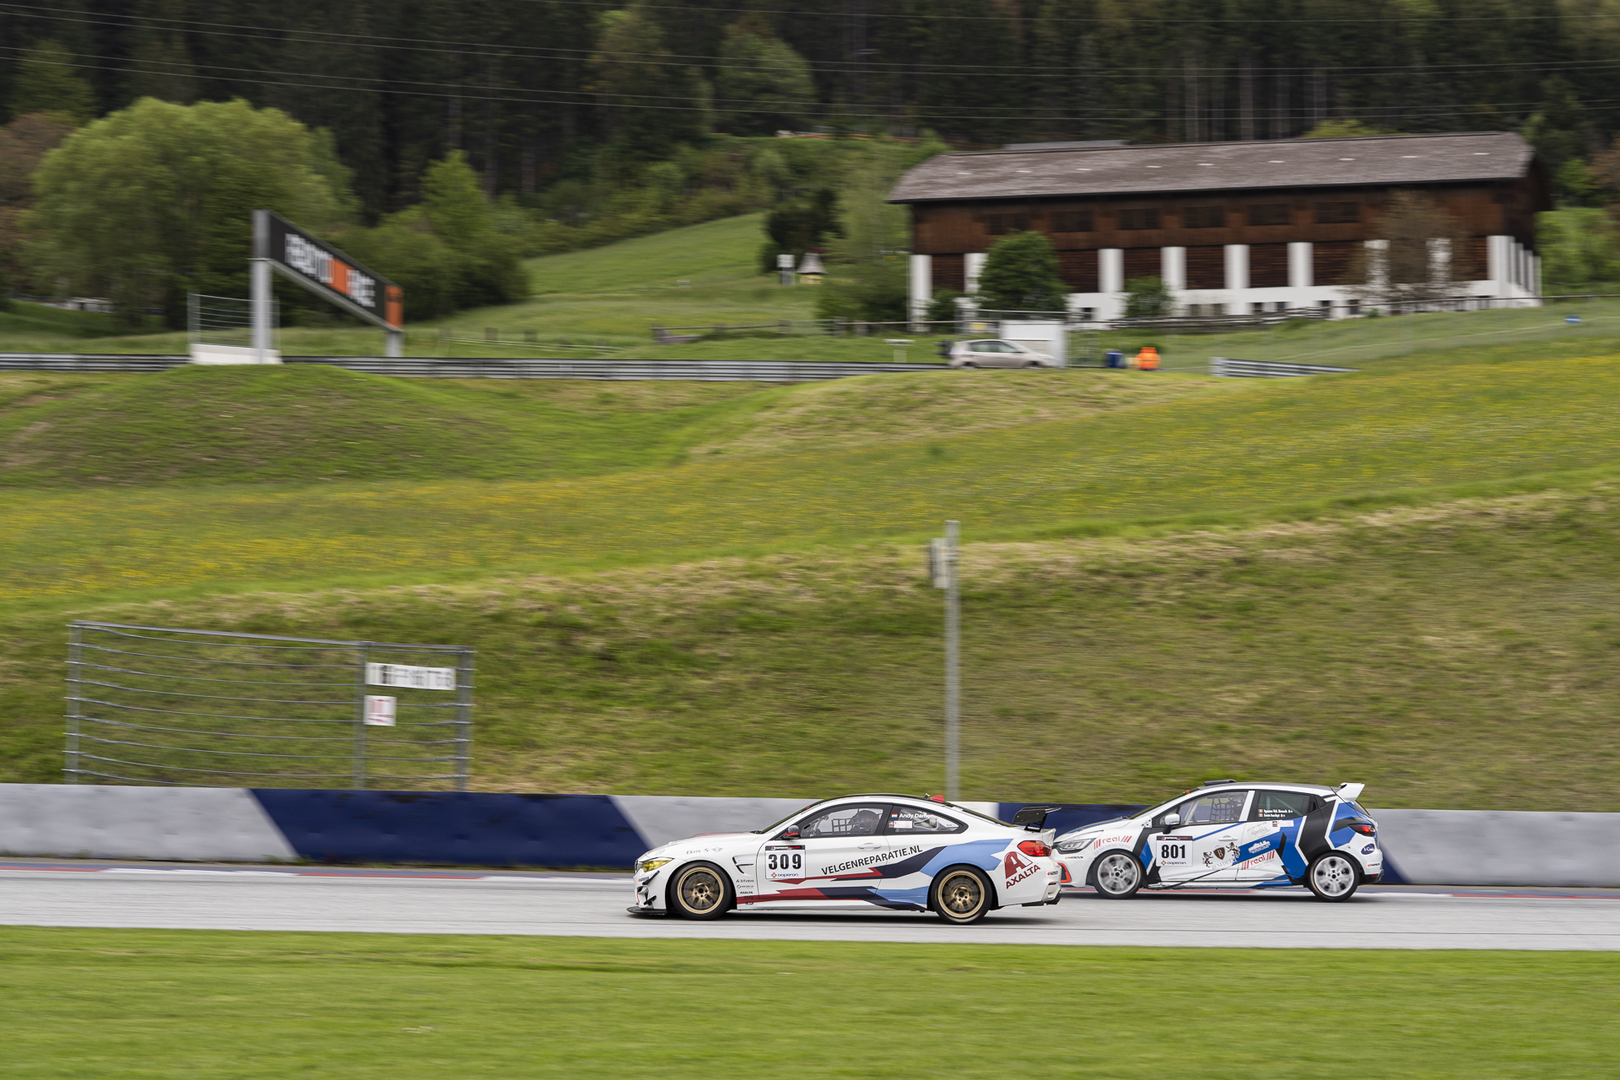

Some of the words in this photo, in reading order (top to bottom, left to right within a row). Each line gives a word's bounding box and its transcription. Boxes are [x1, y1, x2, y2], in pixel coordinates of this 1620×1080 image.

[1102, 836, 1120, 844] real
[1162, 844, 1186, 858] 801
[768, 854, 802, 870] 309
[821, 844, 922, 876] VELGENREPARATIE.NL
[1250, 854, 1266, 865] real
[1006, 865, 1041, 889] AXALTA
